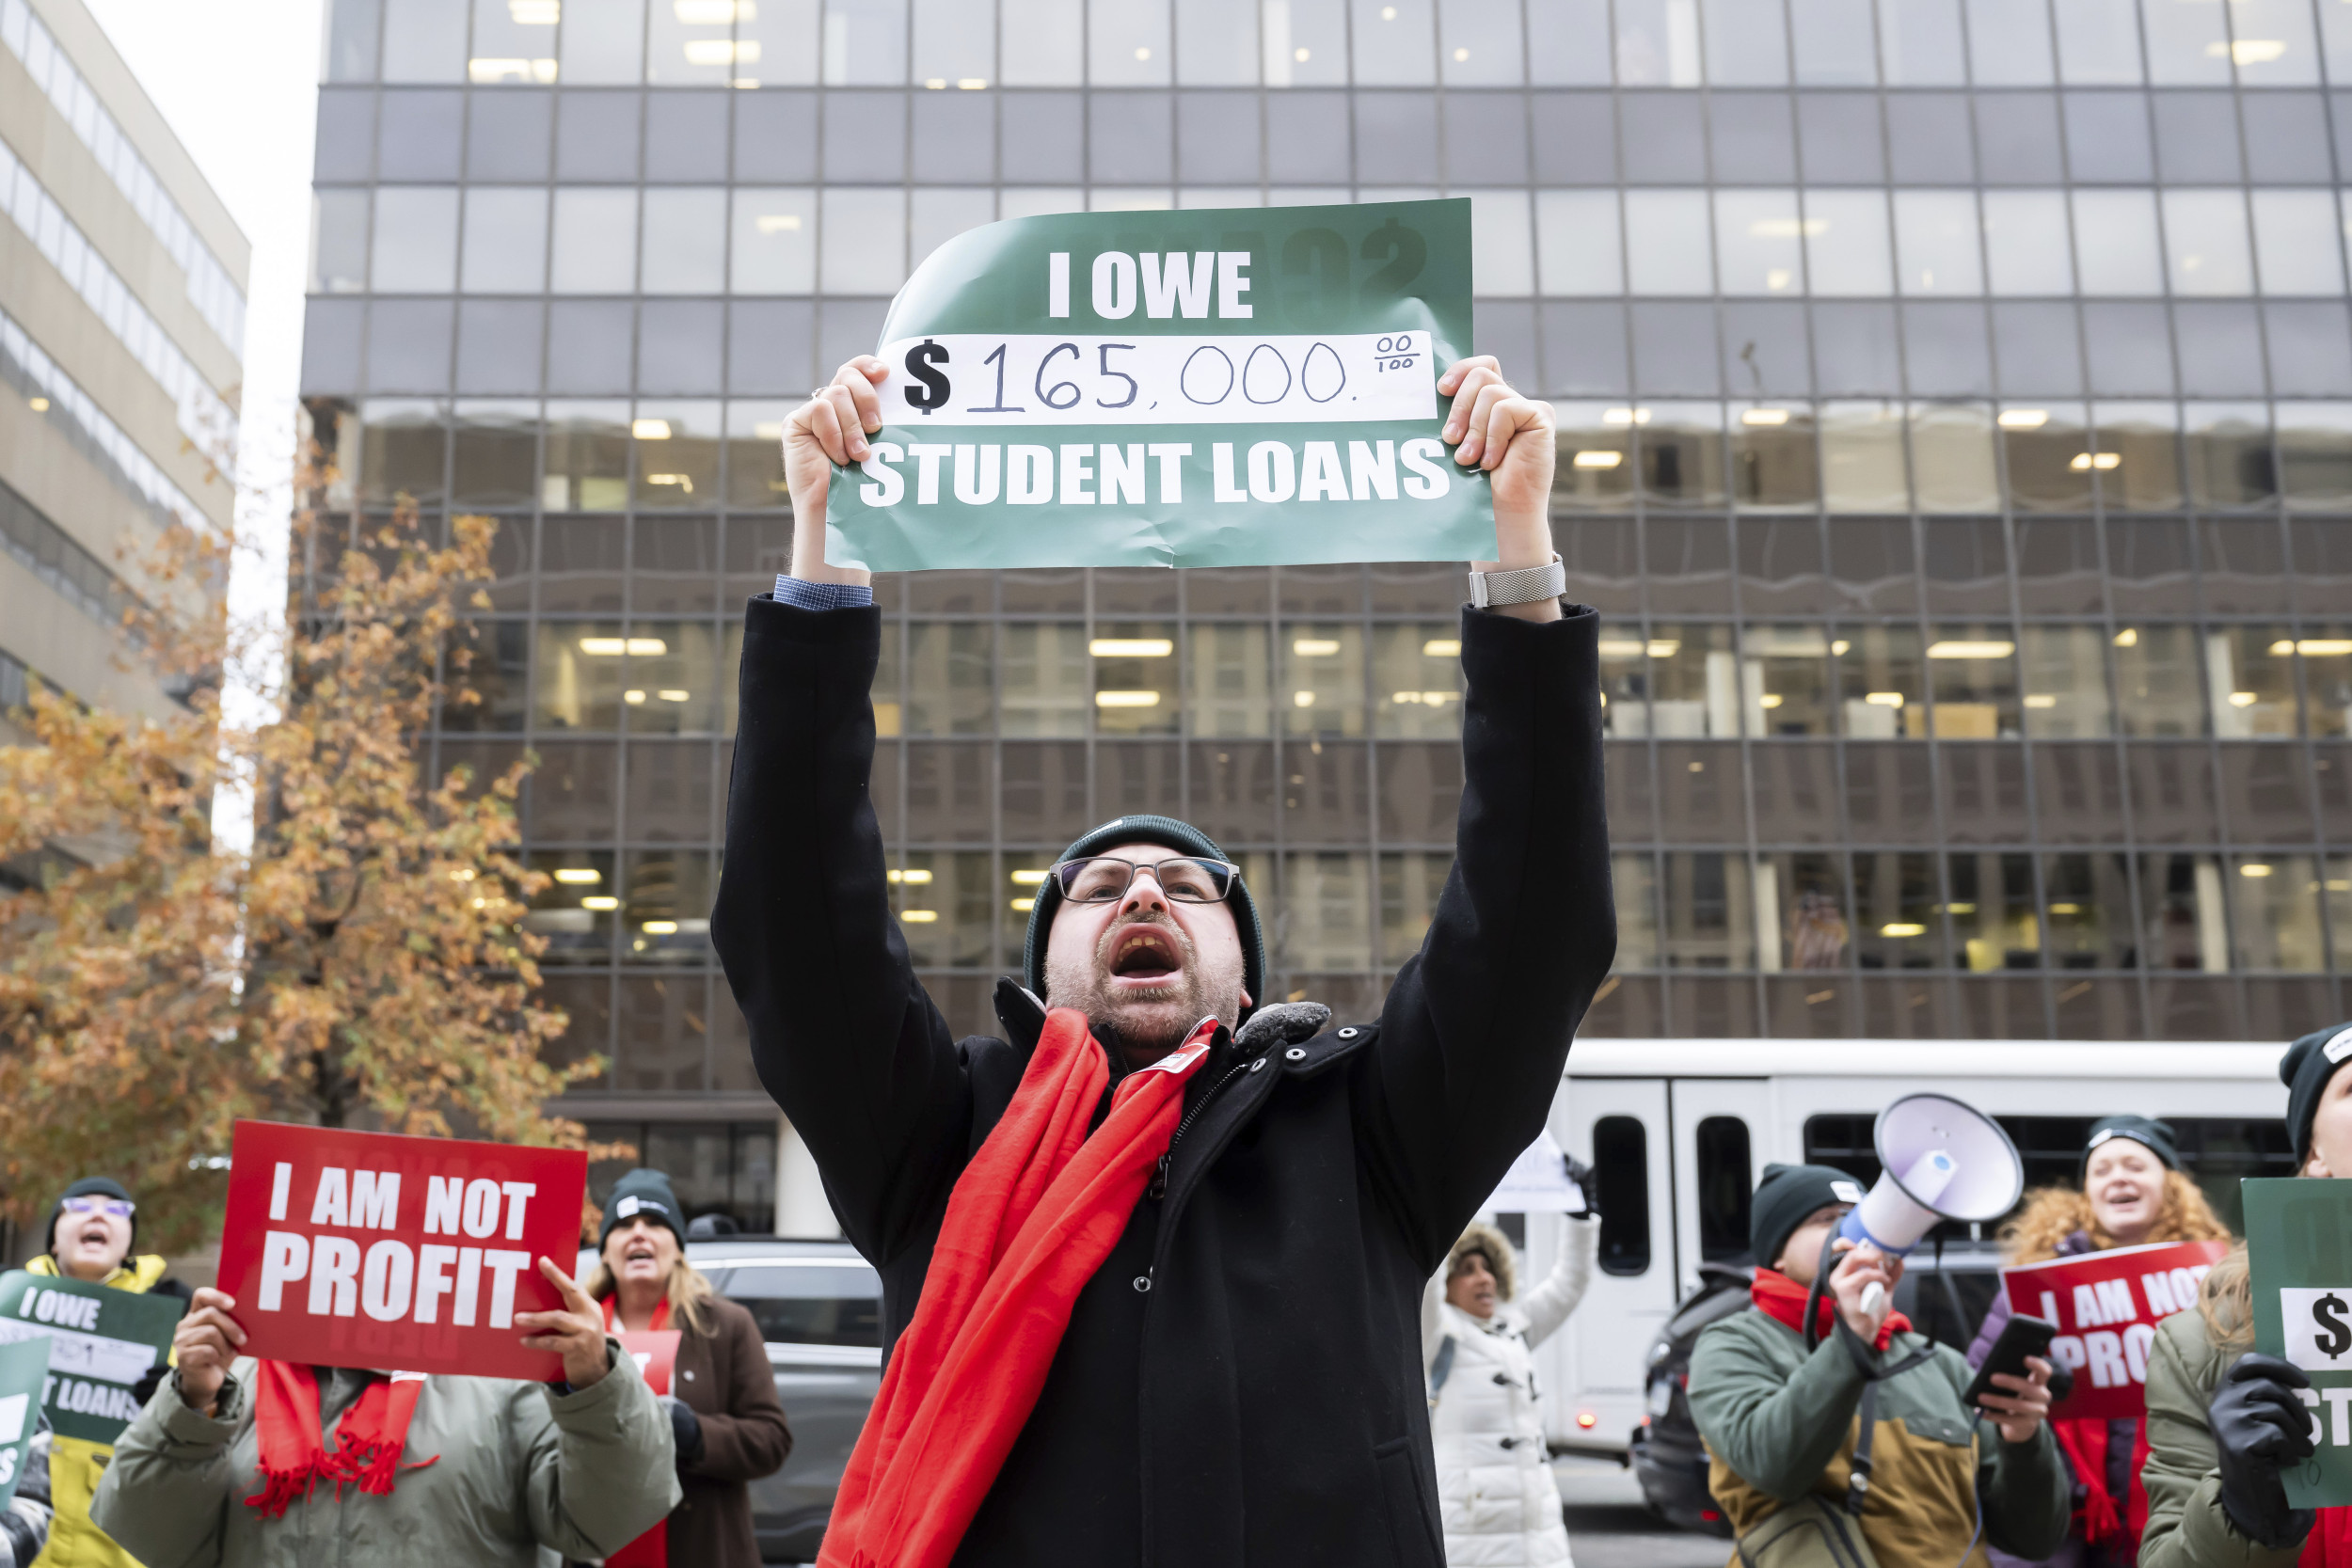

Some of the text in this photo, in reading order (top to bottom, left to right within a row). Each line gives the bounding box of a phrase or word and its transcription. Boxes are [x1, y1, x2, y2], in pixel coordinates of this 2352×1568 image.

[1049, 252, 1070, 318] I
[1091, 251, 1253, 320] OWE
[859, 437, 1452, 508] STUDENT LOANS
[268, 1162, 293, 1222] I
[310, 1166, 402, 1231] AM
[422, 1175, 537, 1241] NOT
[19, 1286, 103, 1331] I OWE
[257, 1229, 532, 1330] PROFIT
[2039, 1291, 2060, 1330] I
[2073, 1277, 2137, 1329] AM
[2049, 1323, 2161, 1388] PRO
[2312, 1292, 2352, 1360] $
